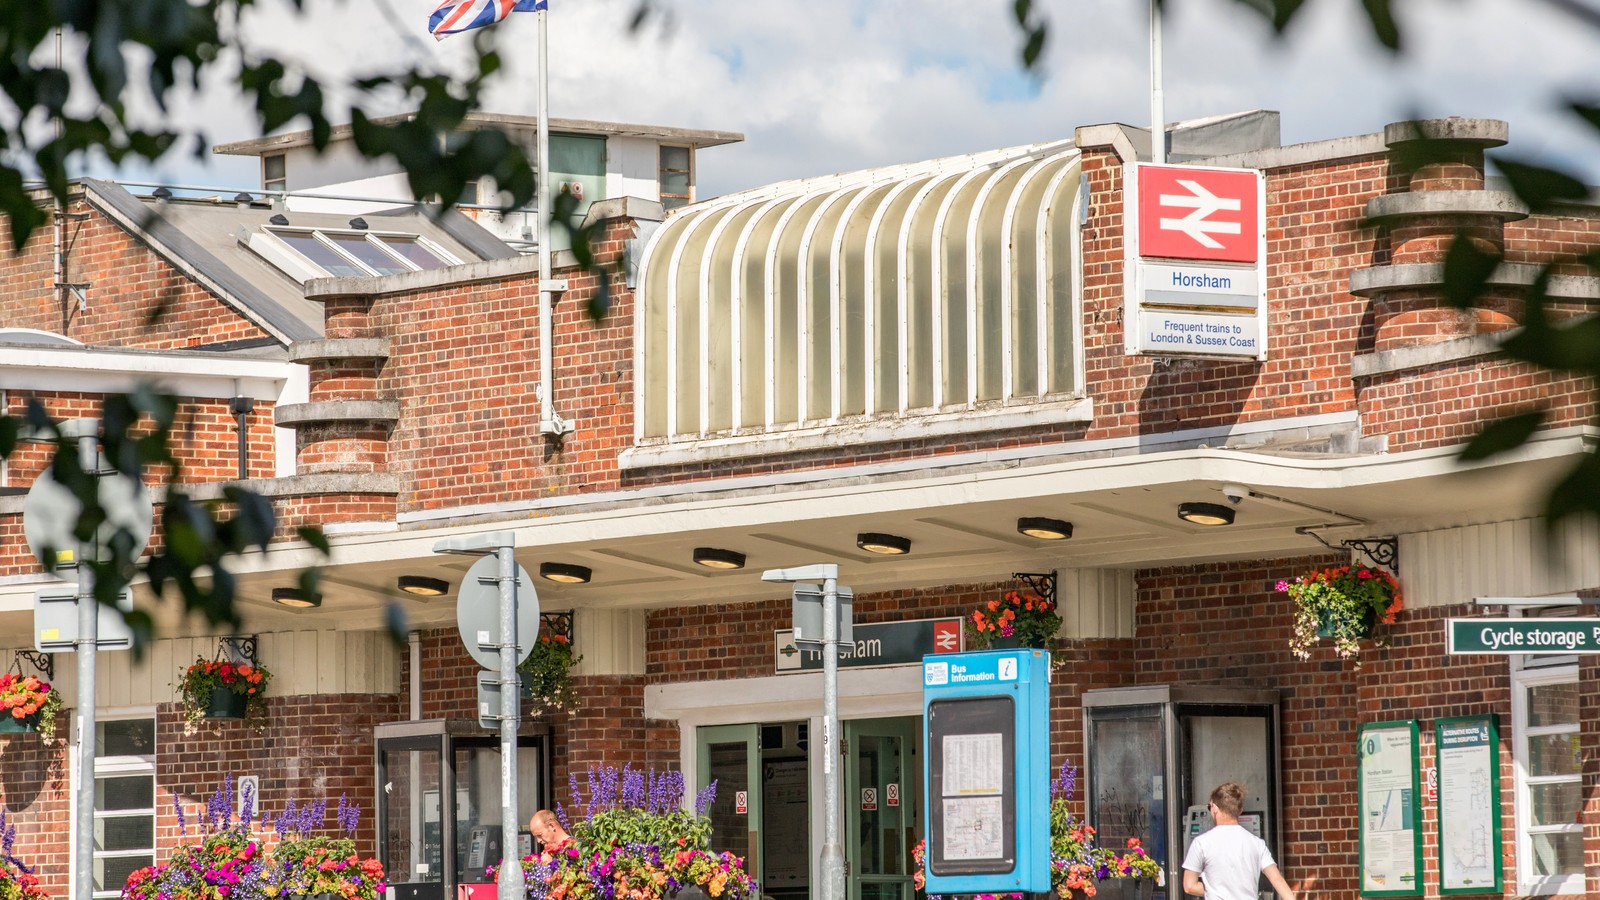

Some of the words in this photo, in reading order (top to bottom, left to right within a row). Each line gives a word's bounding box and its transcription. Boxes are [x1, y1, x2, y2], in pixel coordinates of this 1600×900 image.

[1172, 271, 1231, 289] Horsham
[1164, 320, 1204, 333] Frequent
[1205, 323, 1231, 334] trains
[1232, 324, 1242, 334] to
[1150, 332, 1184, 344] London
[1186, 333, 1193, 344] &
[1195, 334, 1228, 346] Sussex
[1229, 337, 1256, 348] Coast
[1480, 627, 1524, 650] Cycle
[1526, 628, 1586, 650] storage
[951, 664, 967, 673] Bus
[951, 672, 995, 683] Information
